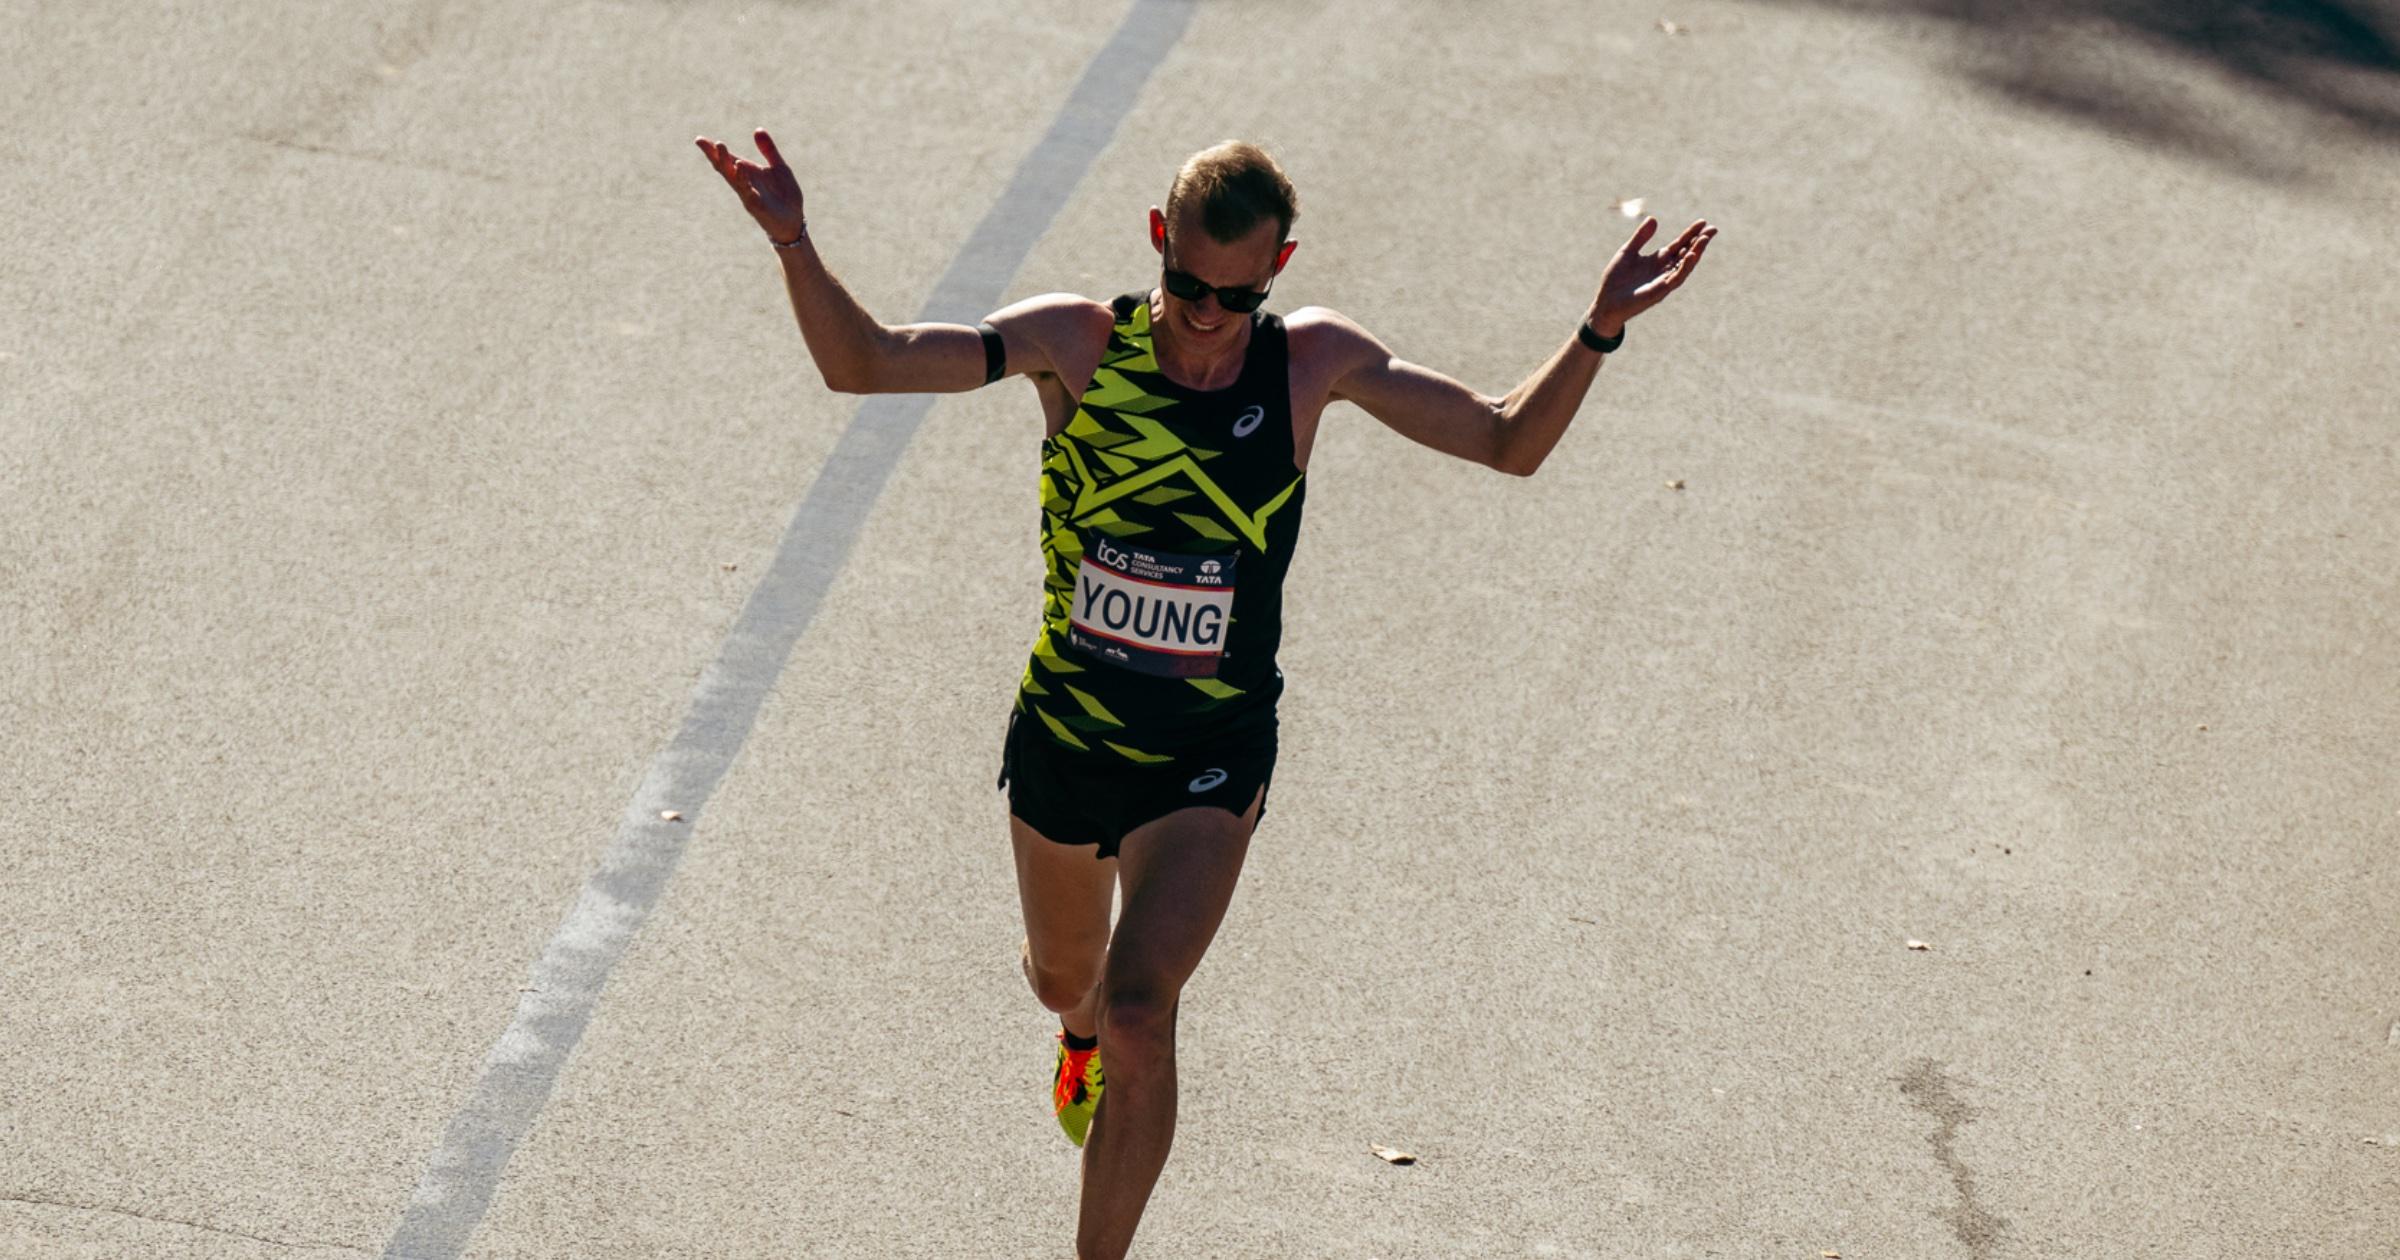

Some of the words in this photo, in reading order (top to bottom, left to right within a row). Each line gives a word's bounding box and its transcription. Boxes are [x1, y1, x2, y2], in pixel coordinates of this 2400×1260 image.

[1097, 538, 1128, 570] tcs
[1133, 552, 1155, 563] TATA
[1130, 566, 1164, 579] SERVICES
[1131, 560, 1184, 574] CONSULTANCY
[1195, 575, 1222, 584] TATA
[1082, 575, 1222, 645] YOUNG
